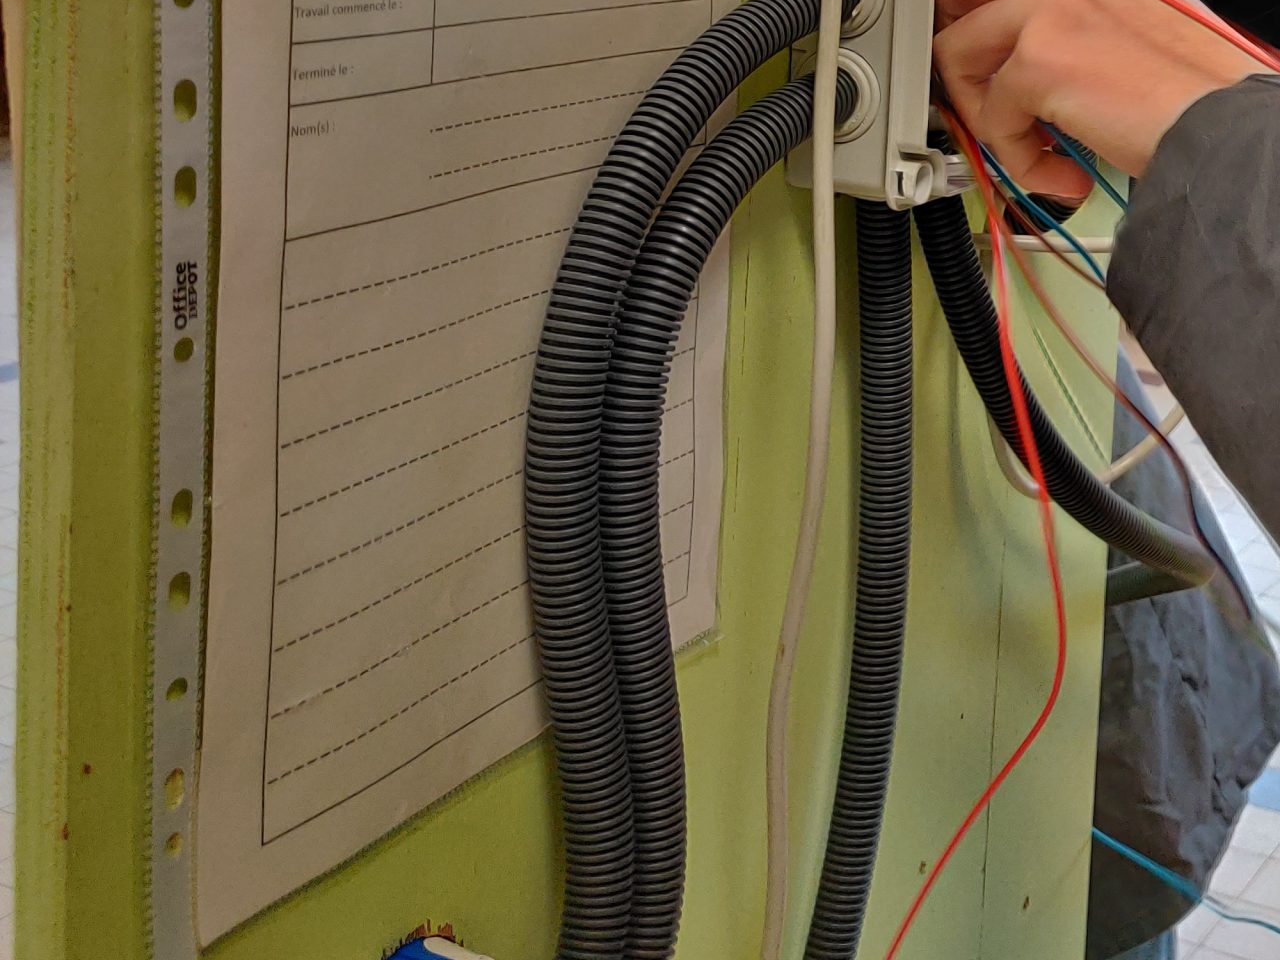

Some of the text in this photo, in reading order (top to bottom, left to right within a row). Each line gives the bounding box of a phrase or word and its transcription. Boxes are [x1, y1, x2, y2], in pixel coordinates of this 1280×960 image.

[295, 5, 329, 18] Travail
[332, 1, 386, 15] commencé
[388, 0, 398, 10] le
[338, 63, 348, 75] le
[291, 120, 330, 137] Nom(s)
[173, 262, 187, 330] Office
[187, 261, 198, 320] DEPOT
